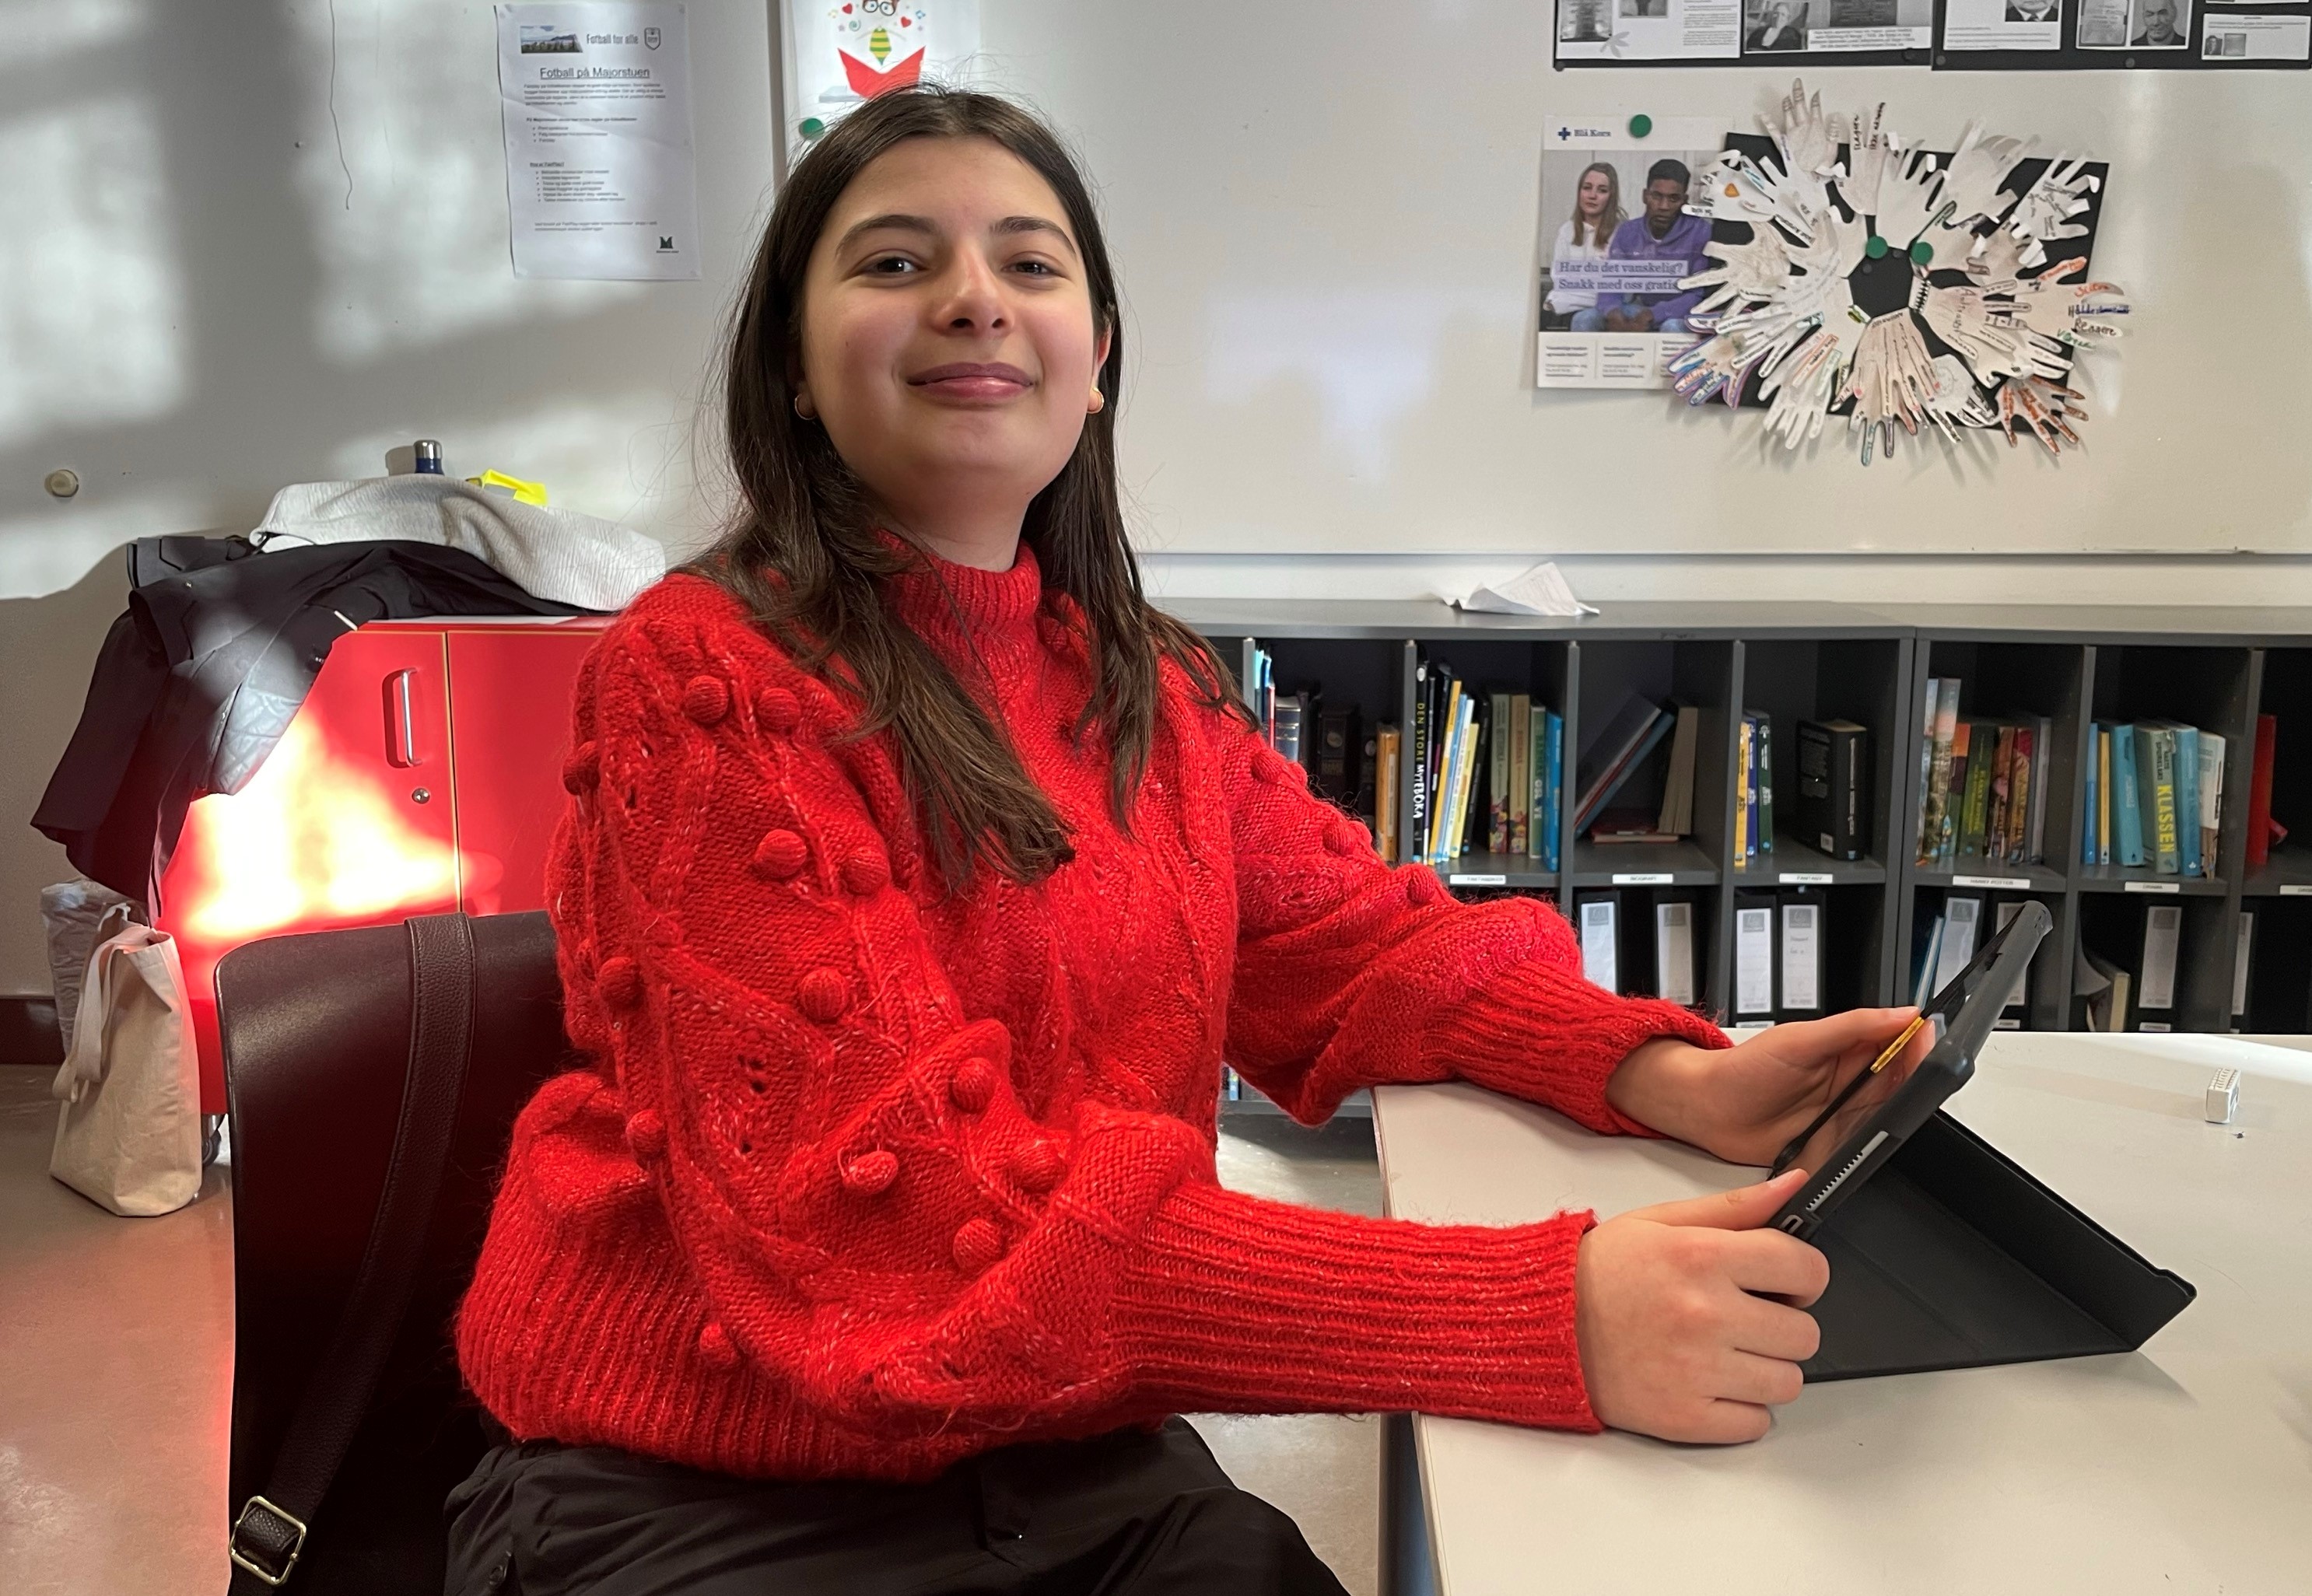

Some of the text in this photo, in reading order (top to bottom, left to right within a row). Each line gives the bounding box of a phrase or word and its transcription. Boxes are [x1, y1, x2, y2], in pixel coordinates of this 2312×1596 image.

[540, 67, 650, 79] Fotball på Majorstuen
[1560, 262, 1683, 275] Har du det vanskelig?
[1558, 279, 1595, 289] Snakk
[1597, 279, 1622, 289] med
[1413, 702, 1425, 818] DEN STORE MYTEBOKA
[2156, 784, 2175, 852] KLASSEN
